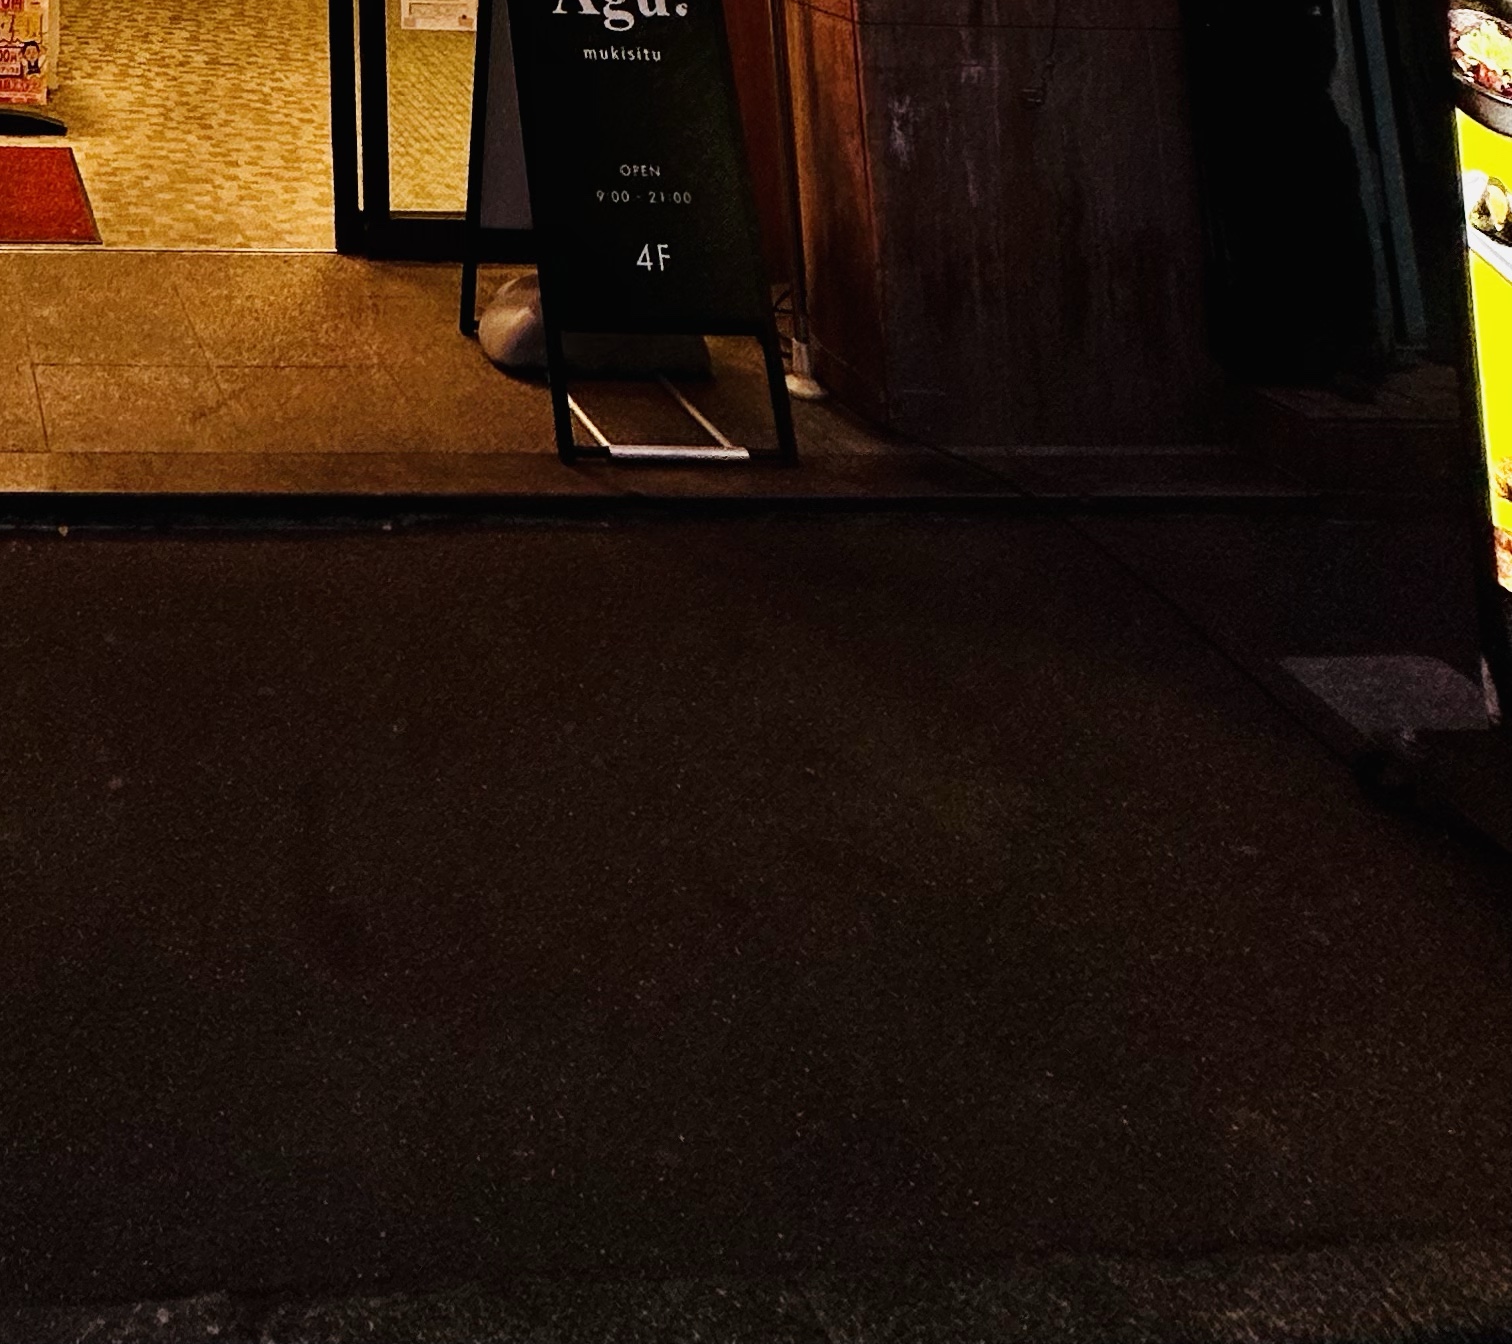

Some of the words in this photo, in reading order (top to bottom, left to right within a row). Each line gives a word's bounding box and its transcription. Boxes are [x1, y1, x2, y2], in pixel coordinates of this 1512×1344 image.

[582, 46, 663, 63] mukisitu
[619, 164, 661, 177] OPEN
[636, 243, 671, 272] 4F
